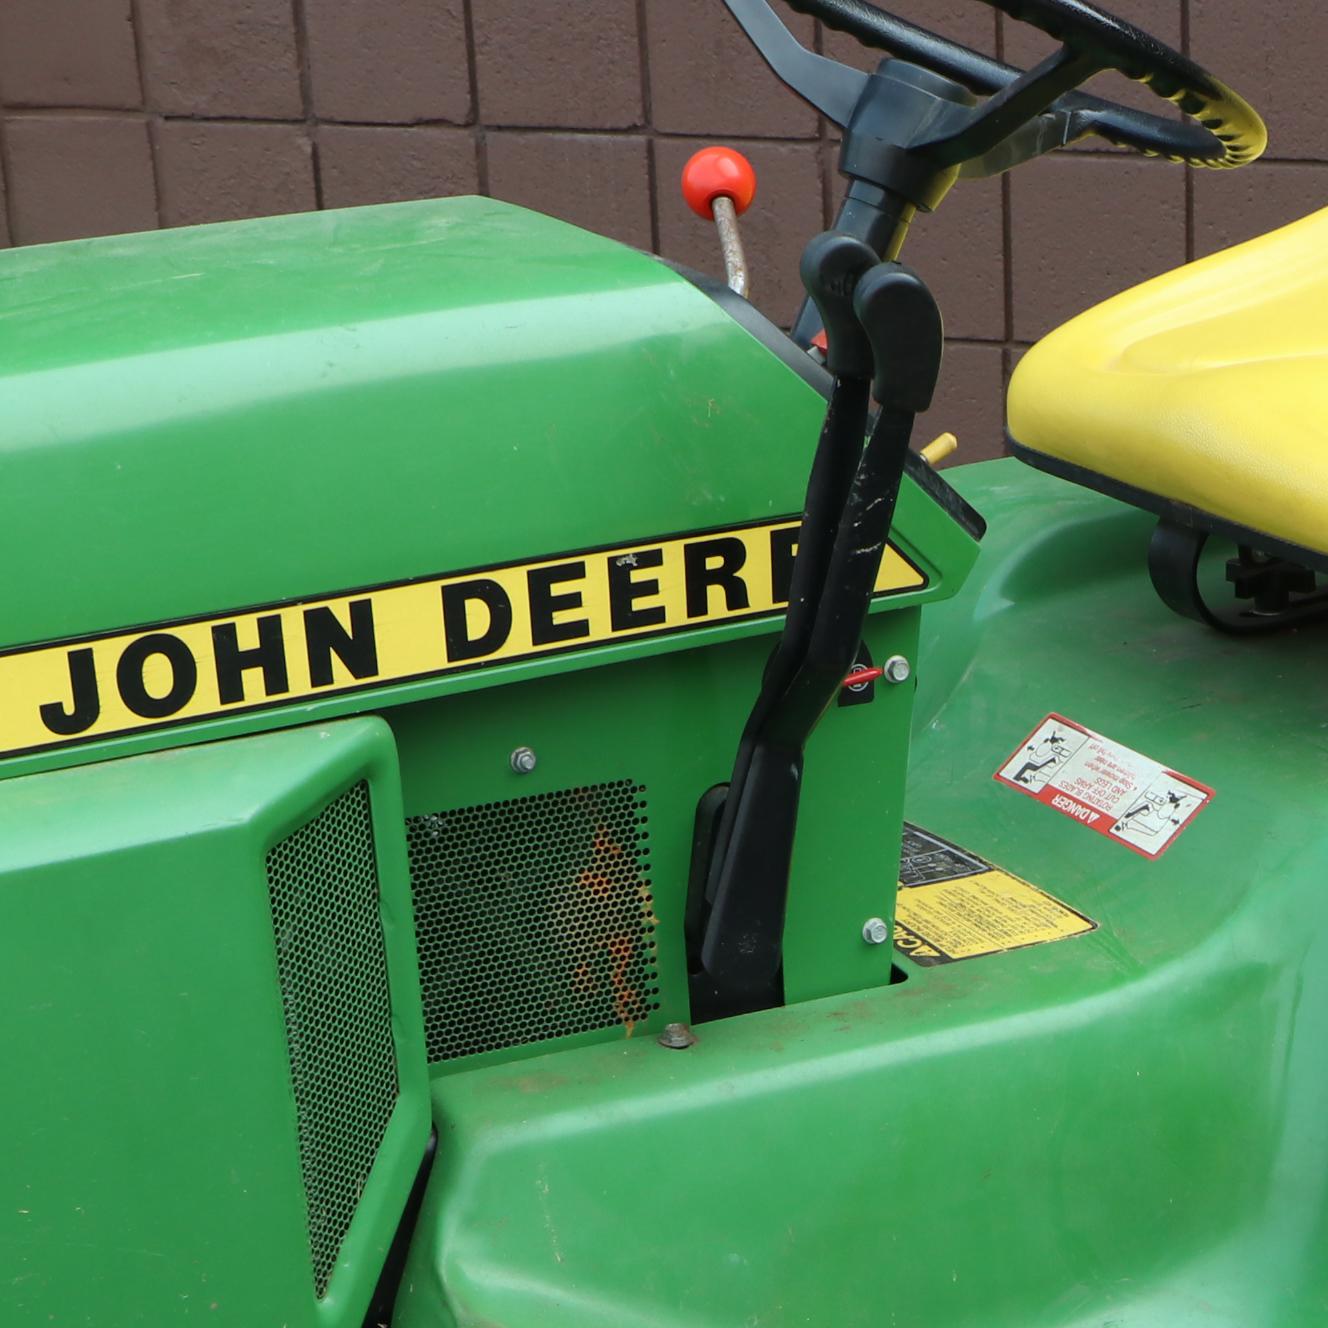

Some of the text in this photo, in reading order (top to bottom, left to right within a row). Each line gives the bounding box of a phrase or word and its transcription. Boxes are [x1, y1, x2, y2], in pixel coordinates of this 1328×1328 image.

[38, 597, 380, 736] JOHN
[1059, 780, 1114, 811] ROTATING BLADES
[1074, 777, 1120, 804] CUT OFF ARMS
[1110, 785, 1126, 796] AND
[1051, 794, 1091, 820] DANGER
